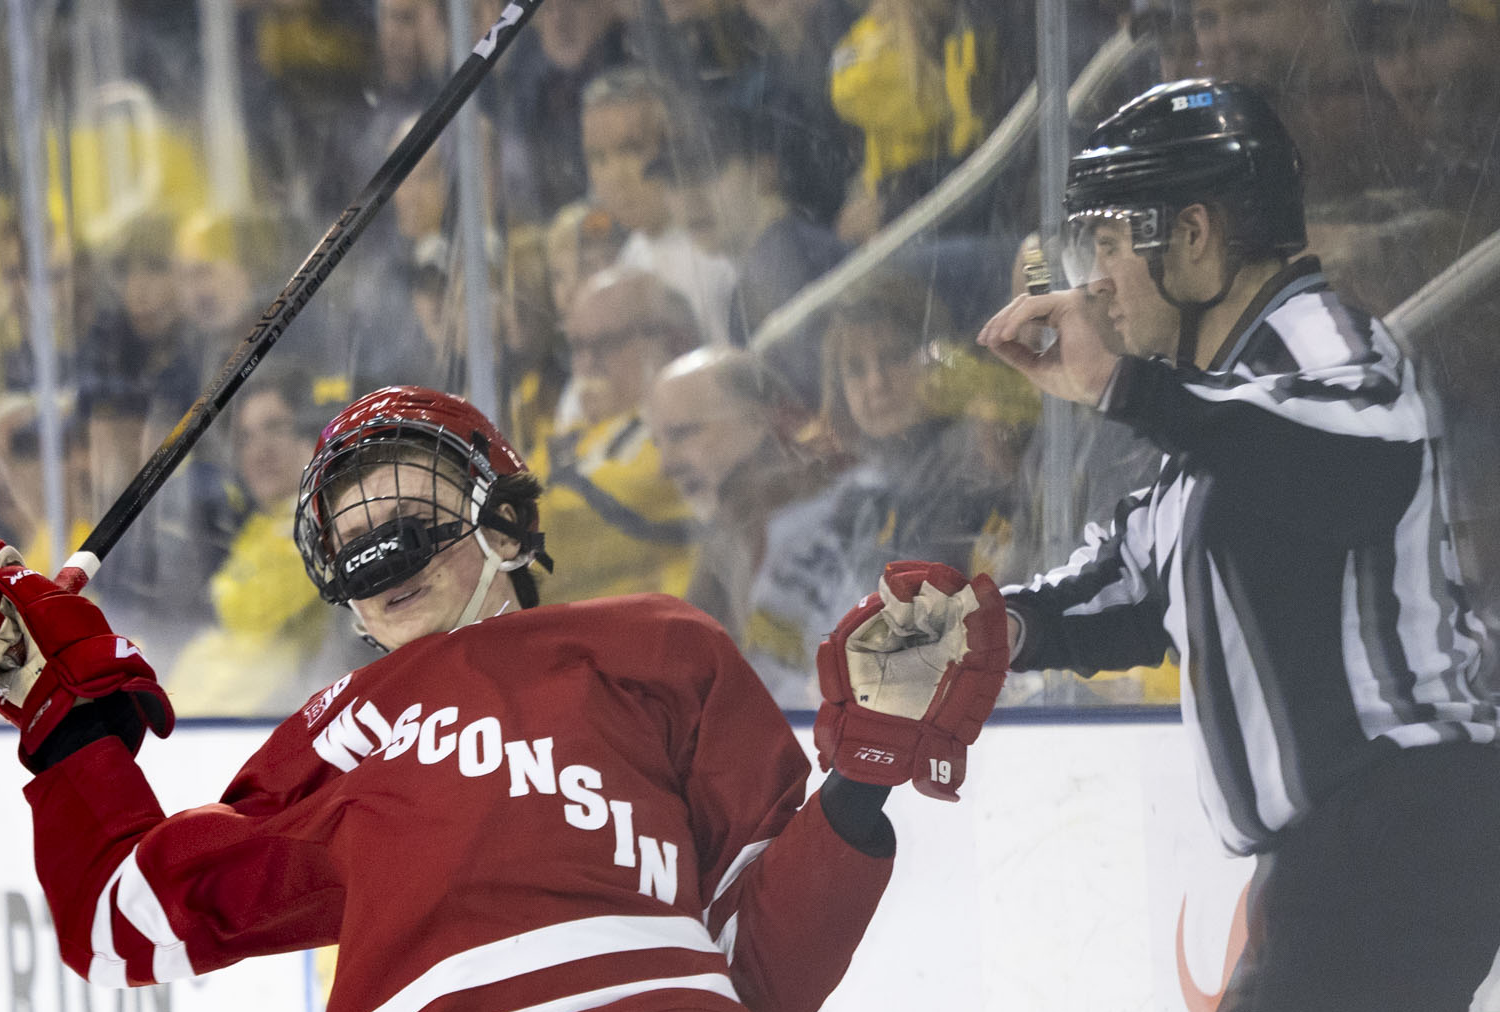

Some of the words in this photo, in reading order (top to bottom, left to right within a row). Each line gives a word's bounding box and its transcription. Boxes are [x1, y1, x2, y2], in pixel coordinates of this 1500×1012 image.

[240, 354, 260, 379] FINLEY
[345, 537, 399, 573] CCM
[929, 758, 952, 785] 19
[313, 697, 679, 906] WISCONSIN
